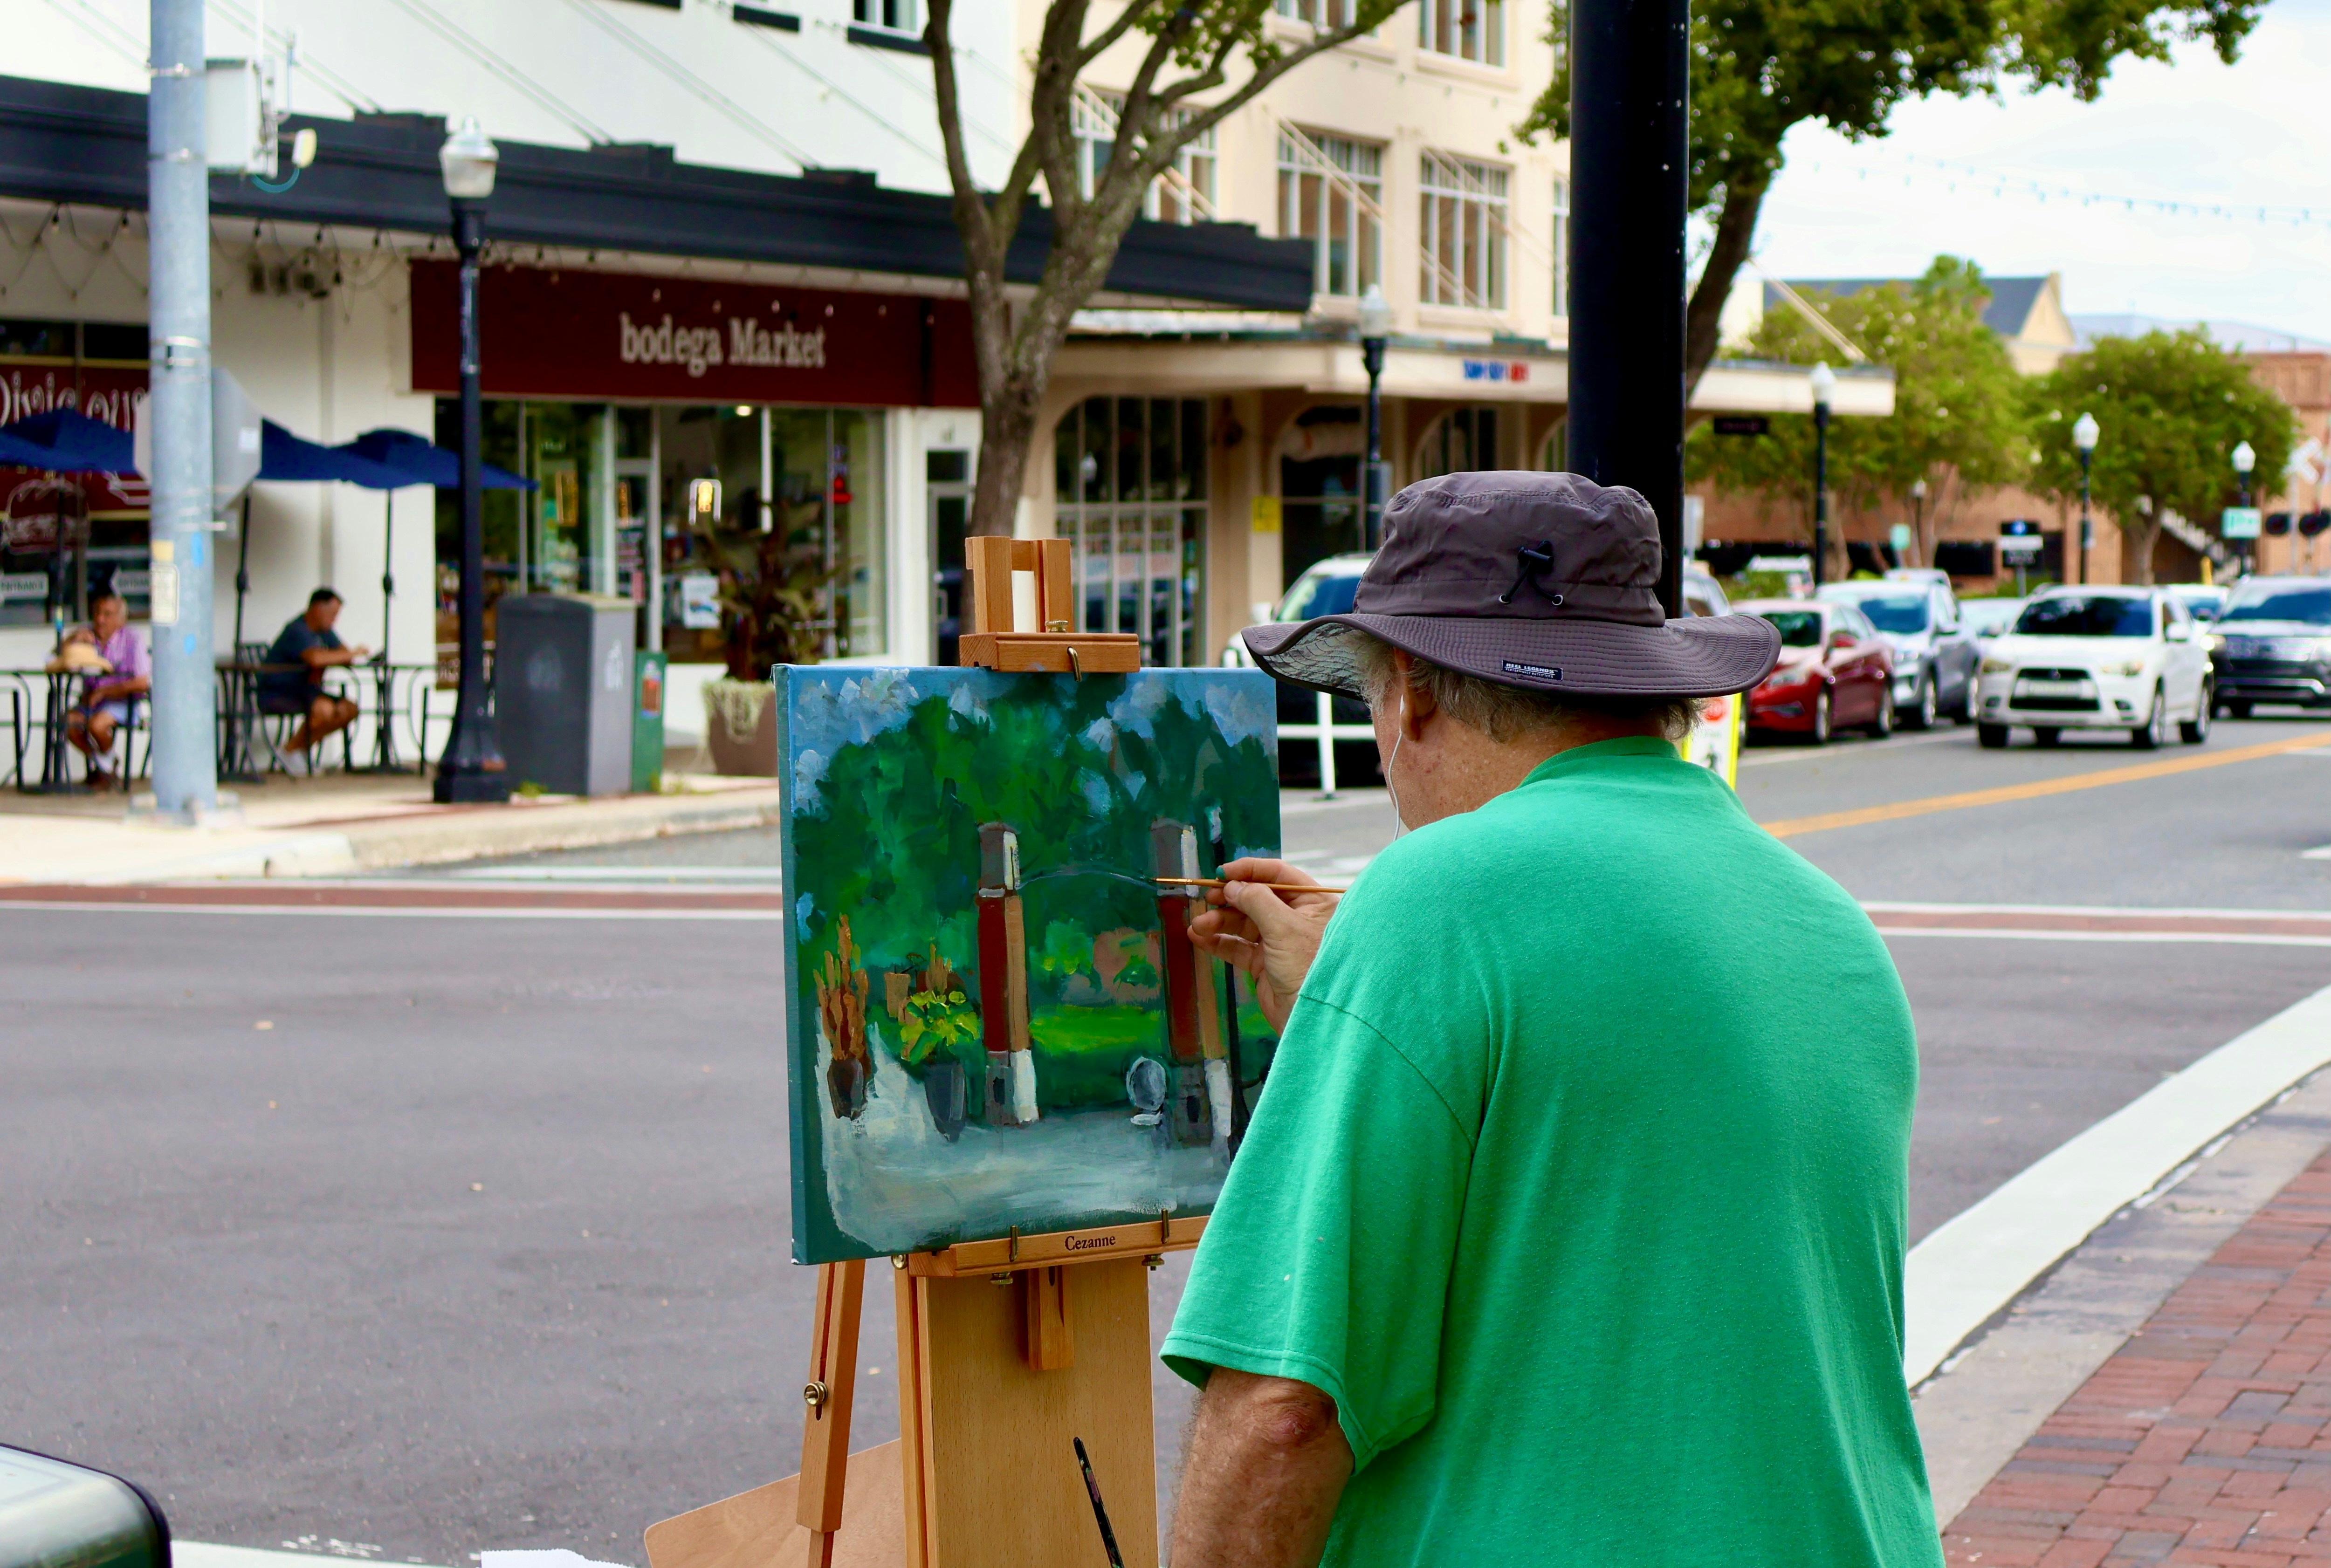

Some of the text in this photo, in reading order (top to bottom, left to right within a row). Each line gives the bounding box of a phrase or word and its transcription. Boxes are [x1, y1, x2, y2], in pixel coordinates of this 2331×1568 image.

[619, 312, 825, 377] bodega Market
[1065, 1236, 1116, 1251] Cezanne
